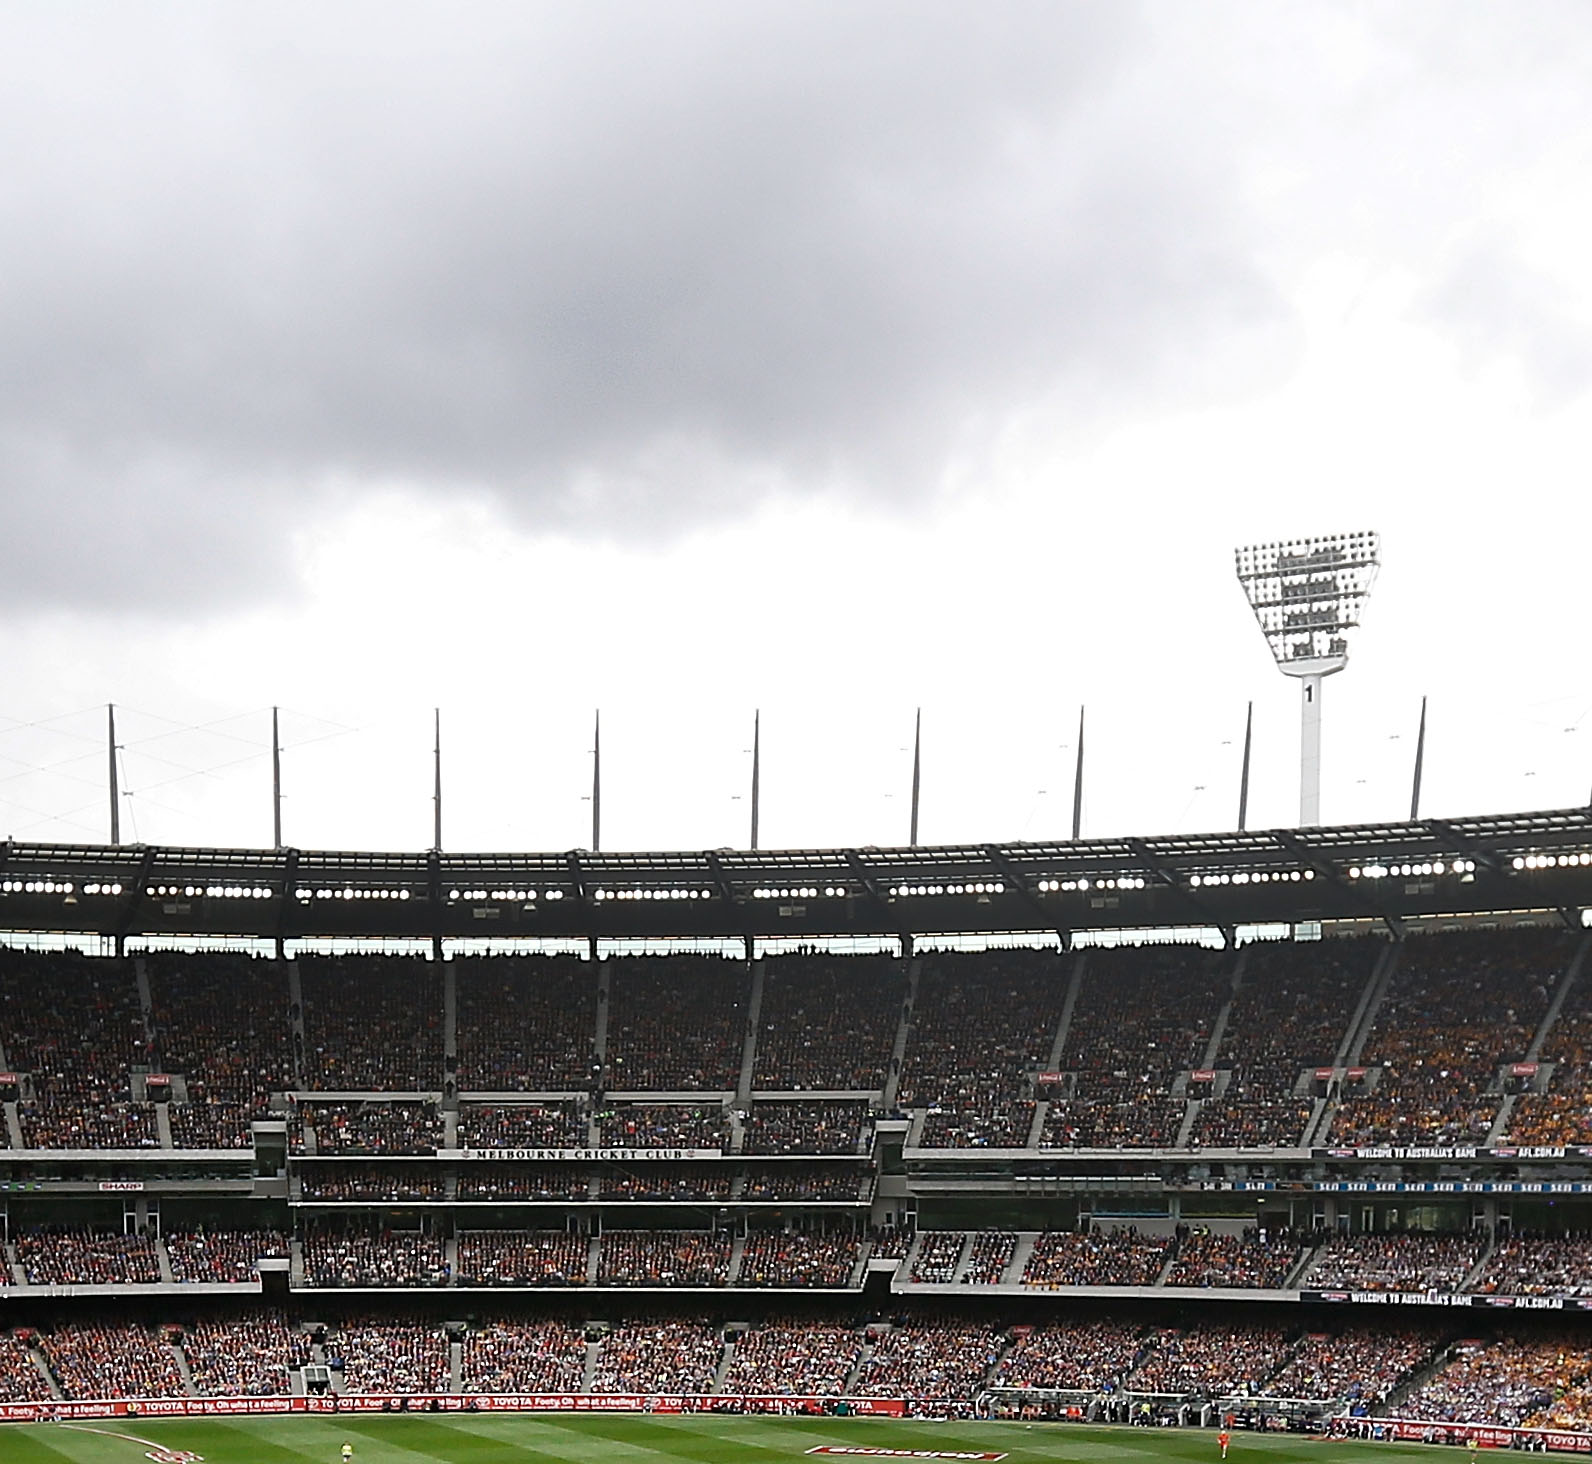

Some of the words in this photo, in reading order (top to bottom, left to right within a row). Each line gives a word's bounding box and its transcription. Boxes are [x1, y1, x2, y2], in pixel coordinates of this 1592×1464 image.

[476, 1149, 567, 1159] MELBOURNE
[575, 1149, 638, 1159] CRICKET
[645, 1149, 684, 1159] CLUB
[1357, 1148, 1392, 1158] WELCOME
[1394, 1148, 1404, 1158] TO
[1406, 1148, 1453, 1158] AUSTRALIA'S
[1455, 1148, 1477, 1158] GAME
[1518, 1147, 1565, 1158] AFL.COM.AU
[102, 1183, 142, 1191] SHARP
[1352, 1293, 1387, 1304] WELCOME
[1389, 1294, 1400, 1304] TO
[1451, 1295, 1473, 1306] GAME
[1515, 1297, 1563, 1309] AFL.COM.AU
[80, 1401, 116, 1413] feeling!
[145, 1401, 185, 1411] TOYOTA
[216, 1400, 231, 1410] Oh
[231, 1399, 255, 1410] what
[263, 1398, 293, 1410] feeling!
[492, 1397, 532, 1407] TOYOTA
[560, 1397, 574, 1406] Oh
[607, 1396, 641, 1408] feeling!
[1481, 1432, 1515, 1446] feeling!
[1548, 1434, 1591, 1447] TOYOTA
